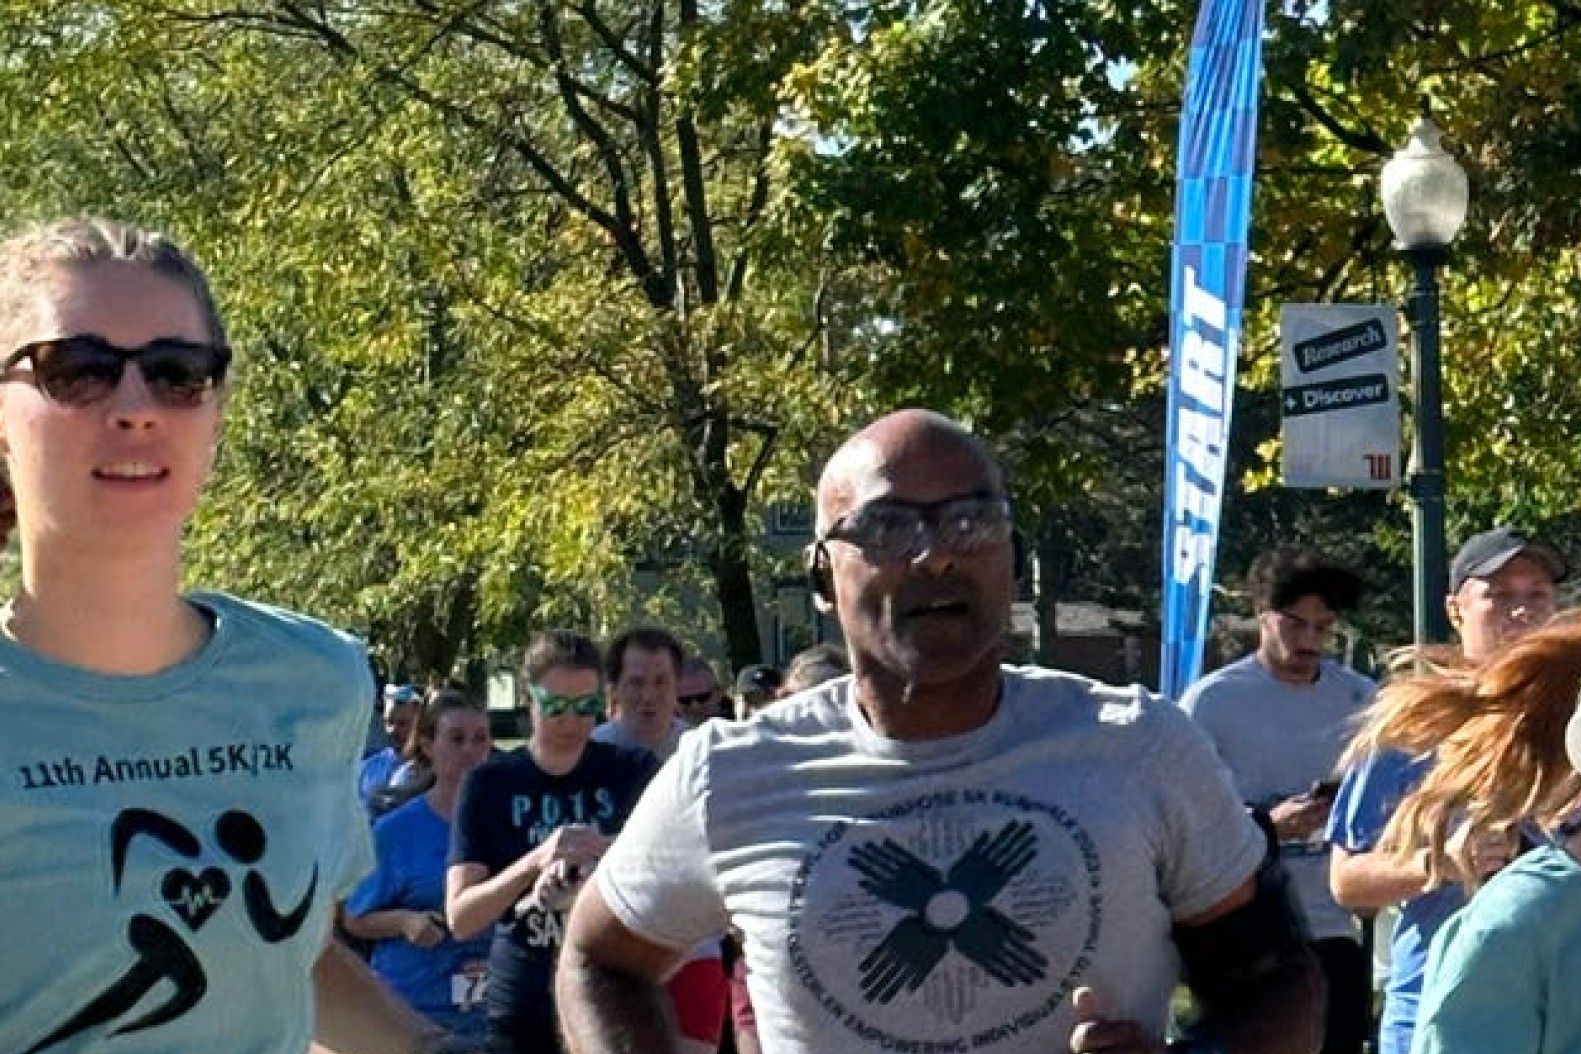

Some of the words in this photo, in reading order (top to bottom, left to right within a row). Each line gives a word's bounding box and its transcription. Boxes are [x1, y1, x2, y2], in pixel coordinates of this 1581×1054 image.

[1303, 323, 1381, 366] Research
[1304, 383, 1384, 409] Discover
[1173, 266, 1227, 584] START
[20, 757, 85, 788] 11th
[93, 747, 202, 784] Annual
[207, 742, 294, 776] 5K/2K
